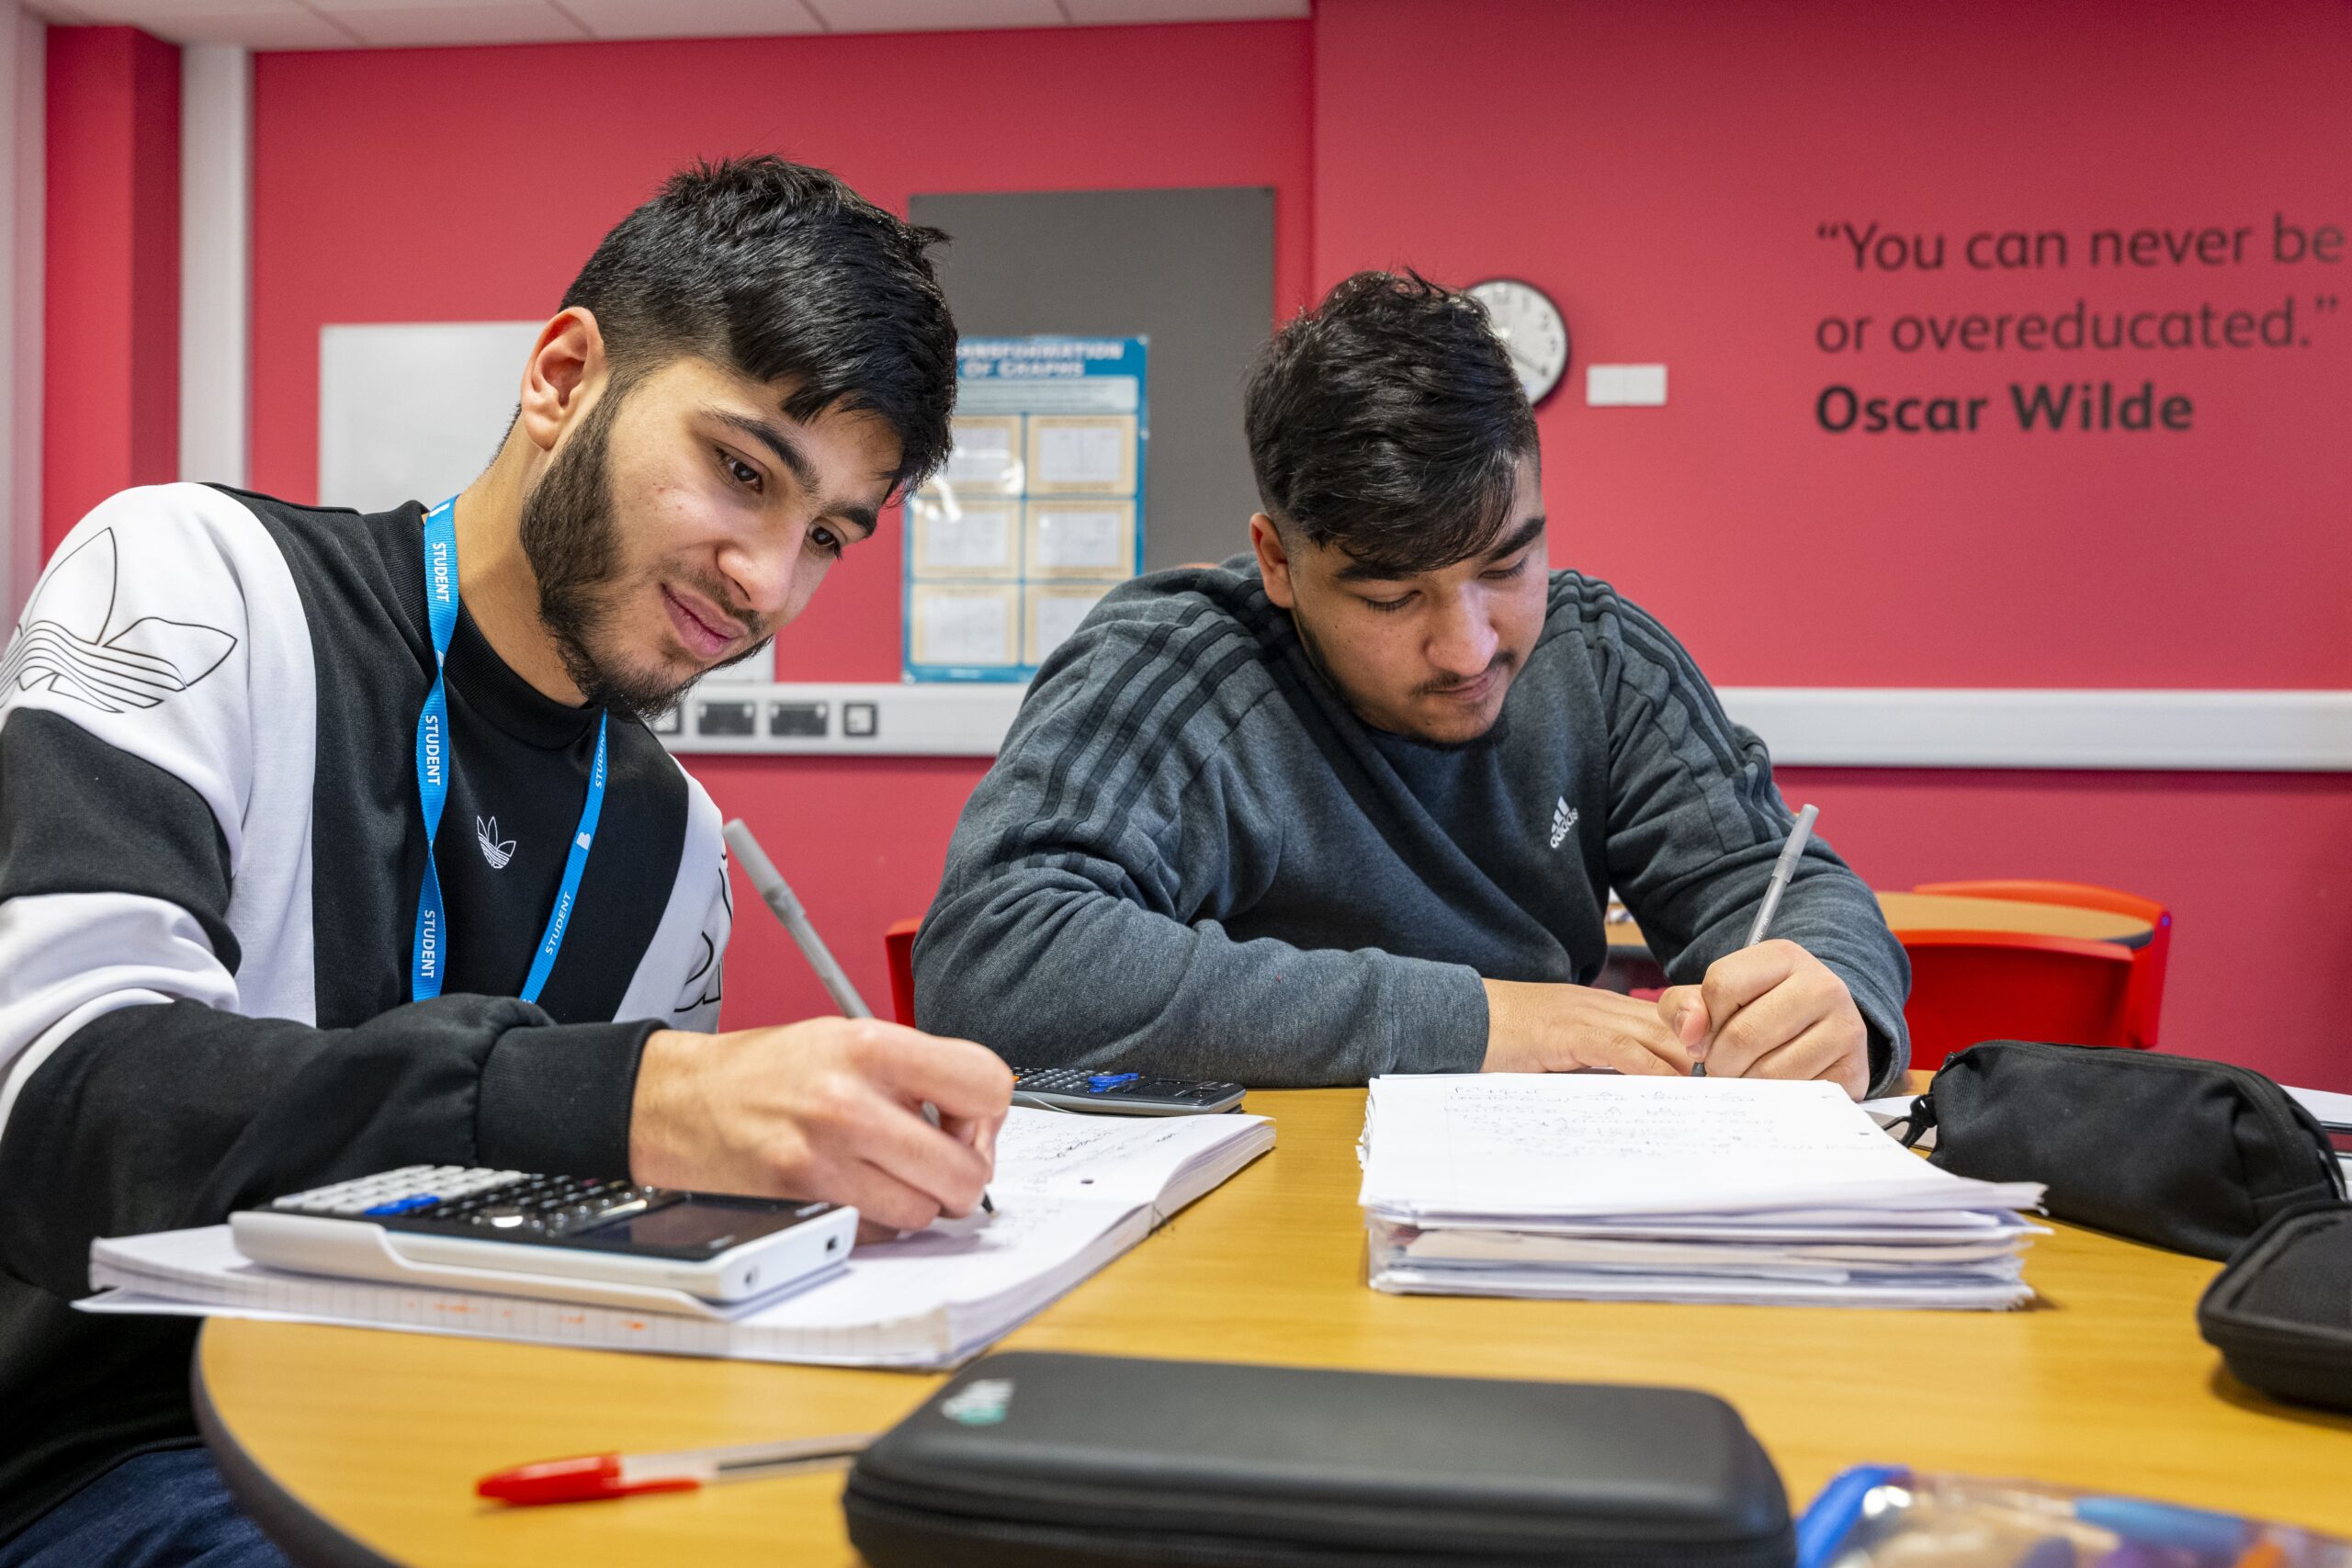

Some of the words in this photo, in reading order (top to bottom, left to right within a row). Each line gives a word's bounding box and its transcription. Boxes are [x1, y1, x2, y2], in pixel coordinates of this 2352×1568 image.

[1816, 221, 1944, 271] “You
[1966, 231, 2067, 269] can
[2090, 226, 2251, 267] never
[2272, 212, 2346, 264] be
[956, 344, 1125, 359] ANSFORMATION
[1815, 316, 1871, 353] or
[1815, 385, 1988, 433] Oscar
[2009, 380, 2194, 431] Wilde
[432, 542, 450, 603] STUDENT
[425, 715, 441, 786] STUDENT
[421, 909, 436, 978] STUDENT
[546, 891, 571, 955] STUDENT
